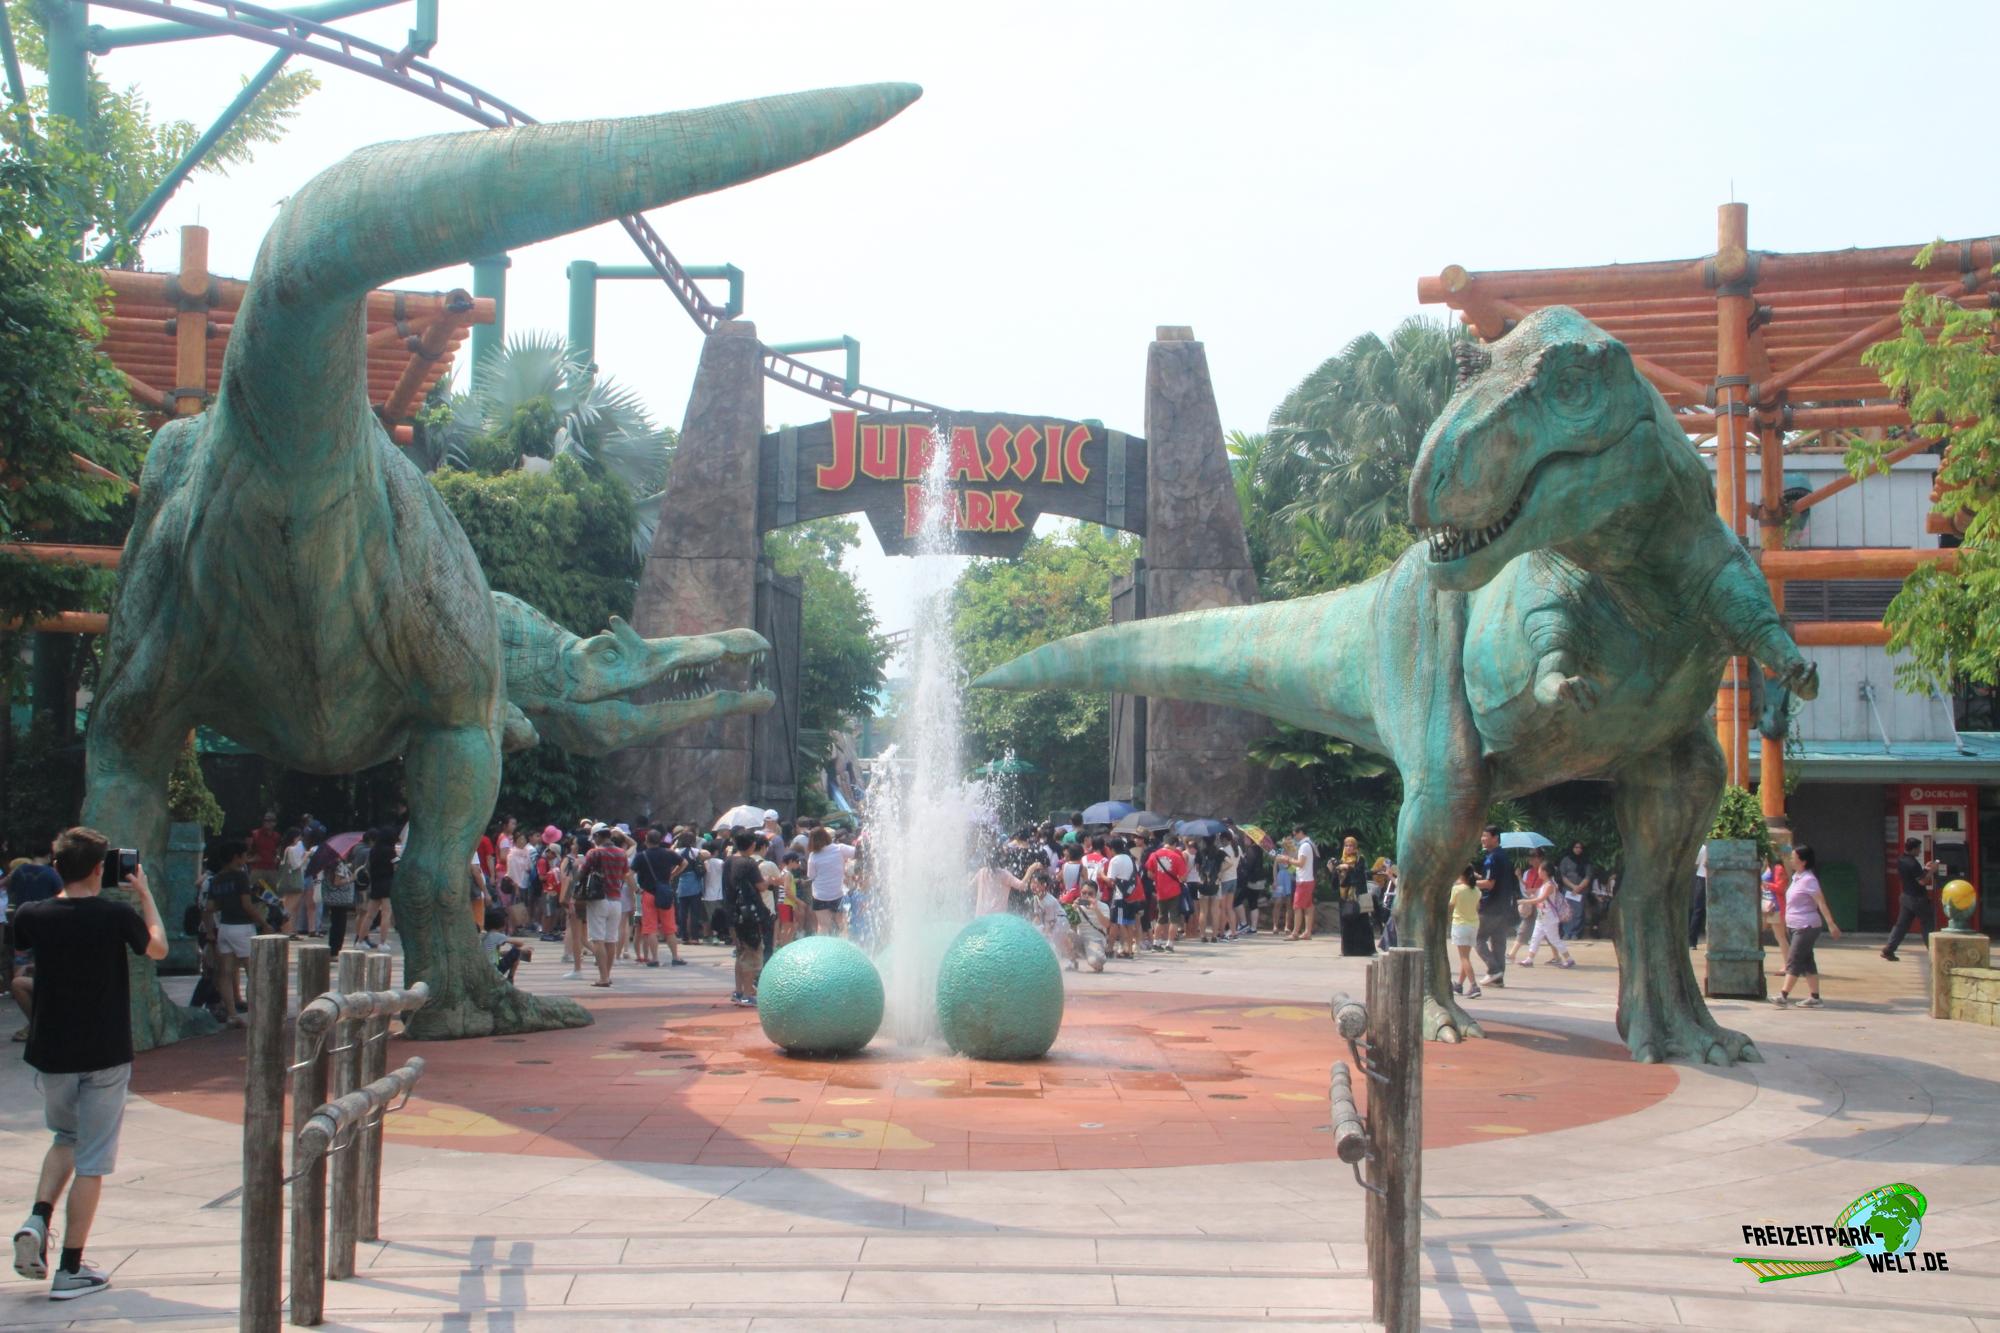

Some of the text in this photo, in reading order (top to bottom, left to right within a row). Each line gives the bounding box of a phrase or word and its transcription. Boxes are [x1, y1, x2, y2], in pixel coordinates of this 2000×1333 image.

[817, 409, 1092, 491] JURASSIC
[1924, 790, 1968, 799] OCBC Bank
